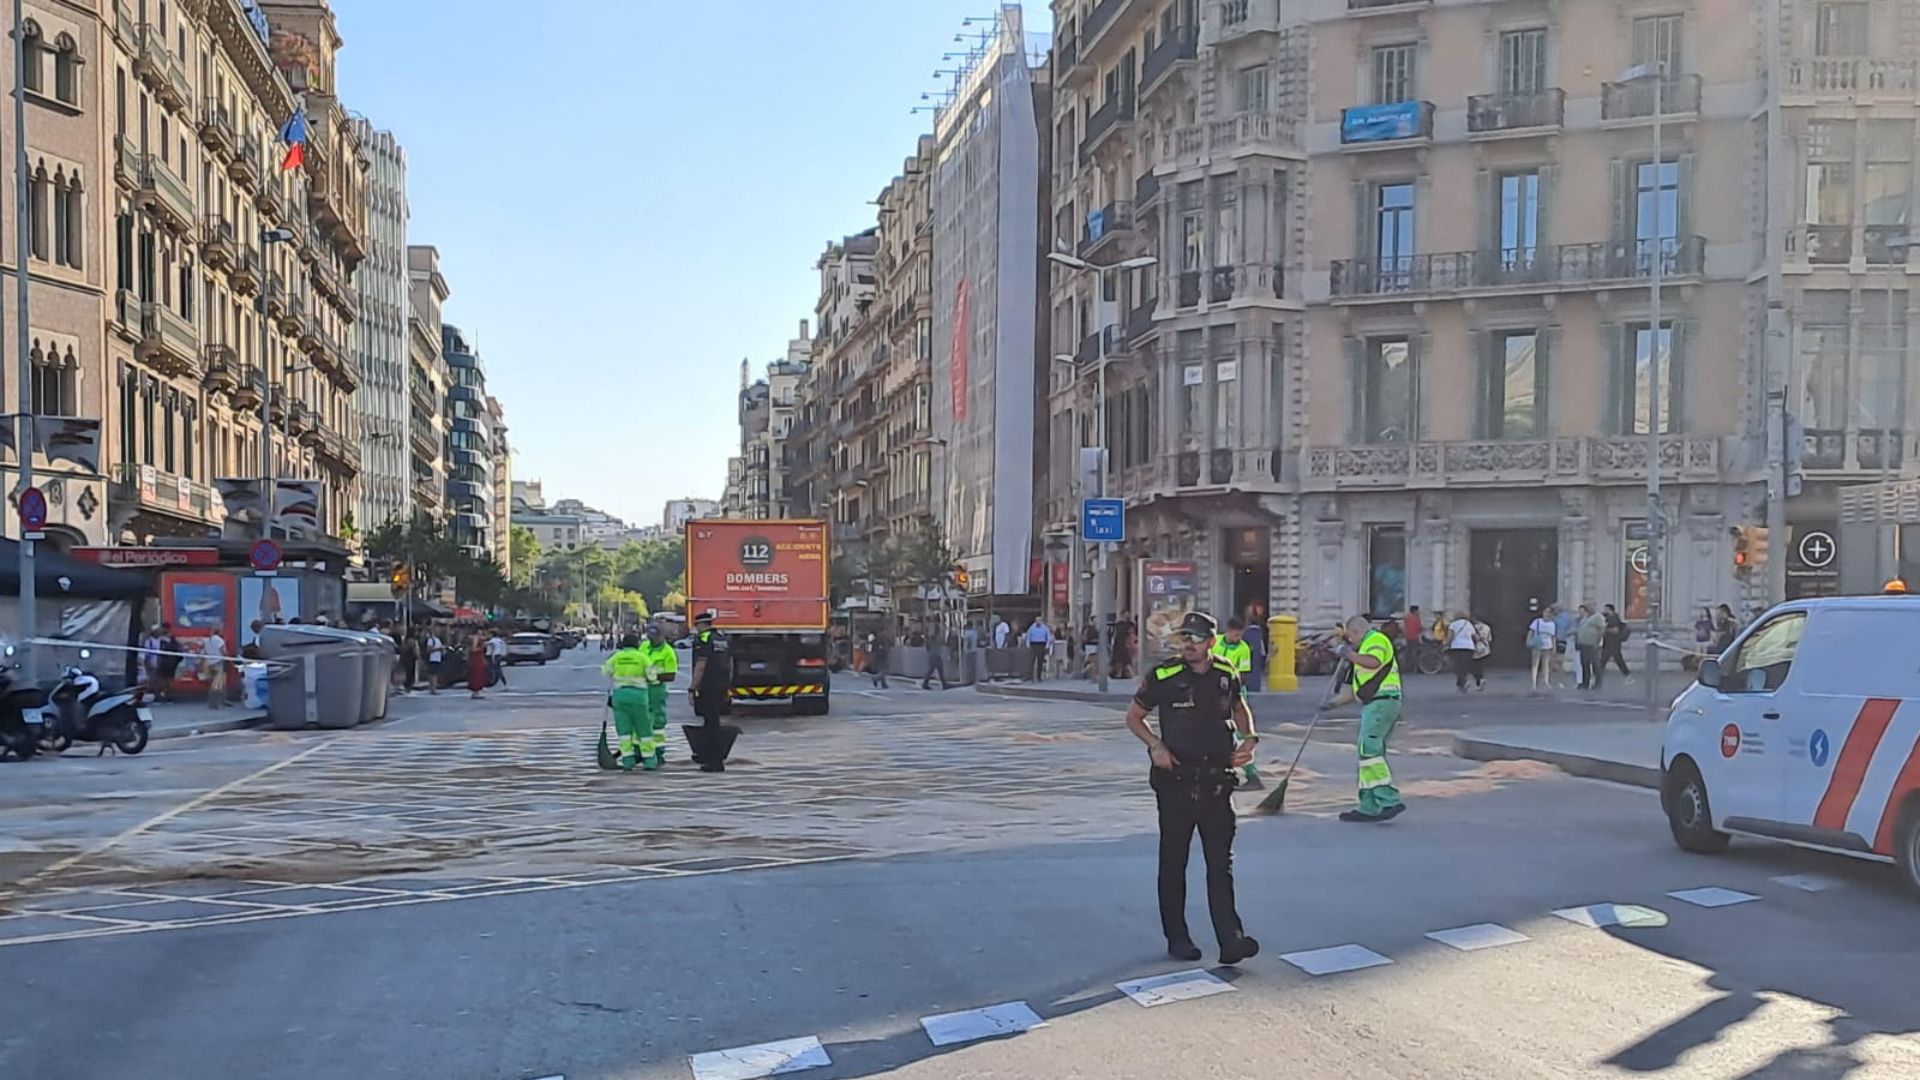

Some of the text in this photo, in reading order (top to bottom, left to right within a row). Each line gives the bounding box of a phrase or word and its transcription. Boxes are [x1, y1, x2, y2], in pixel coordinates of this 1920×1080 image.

[112, 551, 188, 564] el Periódico
[743, 544, 769, 558] 112
[726, 573, 788, 584] BOMBERS
